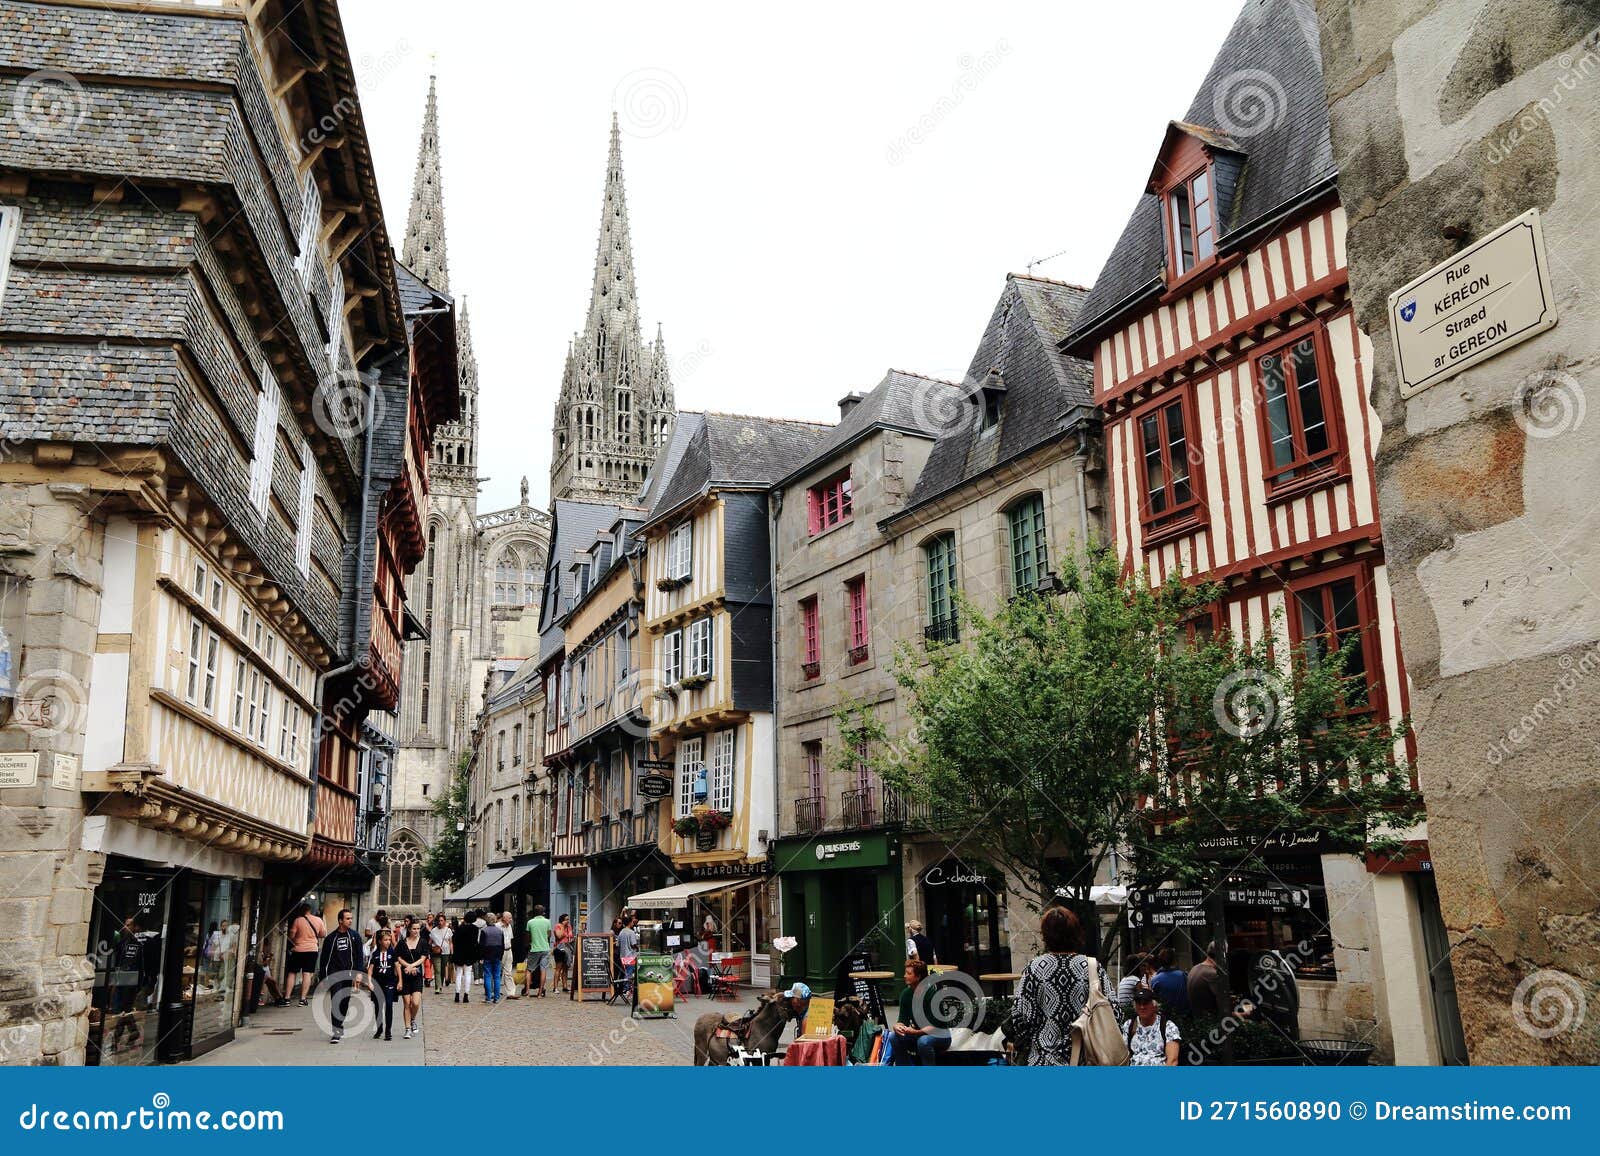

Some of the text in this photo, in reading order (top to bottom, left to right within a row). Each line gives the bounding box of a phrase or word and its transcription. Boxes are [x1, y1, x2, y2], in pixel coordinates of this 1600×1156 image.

[1446, 263, 1471, 285] Rue
[1434, 274, 1490, 315] KÉRÉON
[1446, 306, 1487, 338] Straed
[1434, 320, 1508, 369] ar GEREON
[693, 863, 767, 877] MACARONERIE
[1155, 889, 1203, 898] office de tourisme
[1246, 889, 1277, 898] les halles
[1173, 910, 1206, 919] conciergerie
